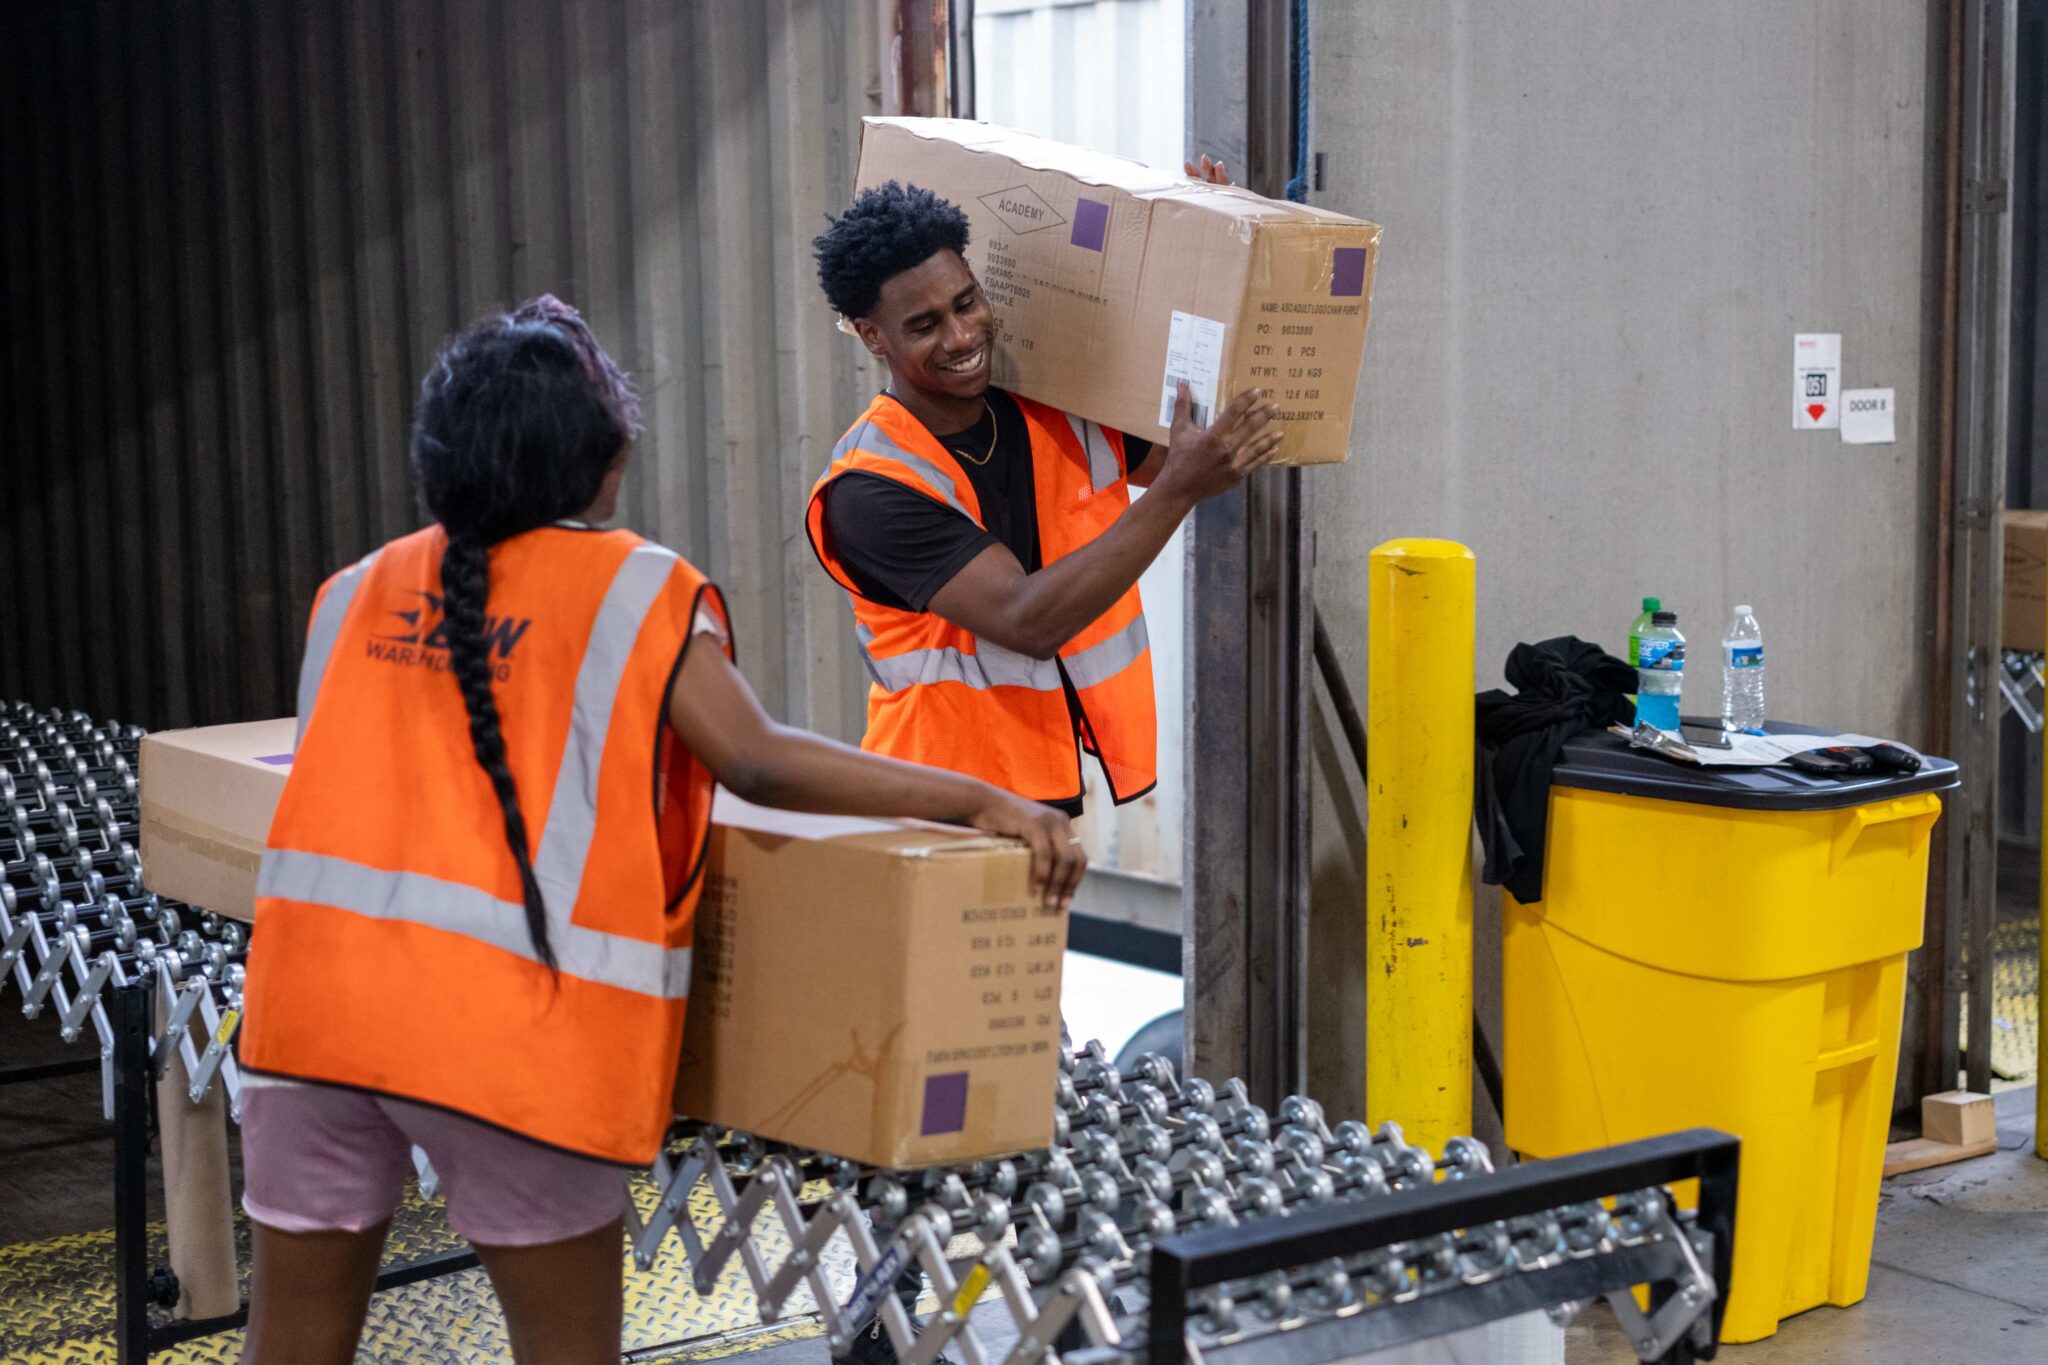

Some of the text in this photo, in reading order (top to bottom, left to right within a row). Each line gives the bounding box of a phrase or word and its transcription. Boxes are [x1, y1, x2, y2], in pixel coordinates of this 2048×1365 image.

[998, 198, 1045, 221] ACADEMY
[984, 289, 1015, 307] PURPLE
[1311, 304, 1328, 315] LOGO
[1256, 323, 1314, 336] PO: 9033880
[1003, 332, 1014, 345] OF
[1021, 338, 1035, 350] 178
[1253, 344, 1274, 356] QTY:
[1301, 346, 1317, 357] PCS
[1250, 366, 1262, 377] NT
[1263, 367, 1279, 377] WT:
[1307, 367, 1323, 378] KGS
[1304, 389, 1320, 400] KGS
[1849, 399, 1878, 412] DOOR
